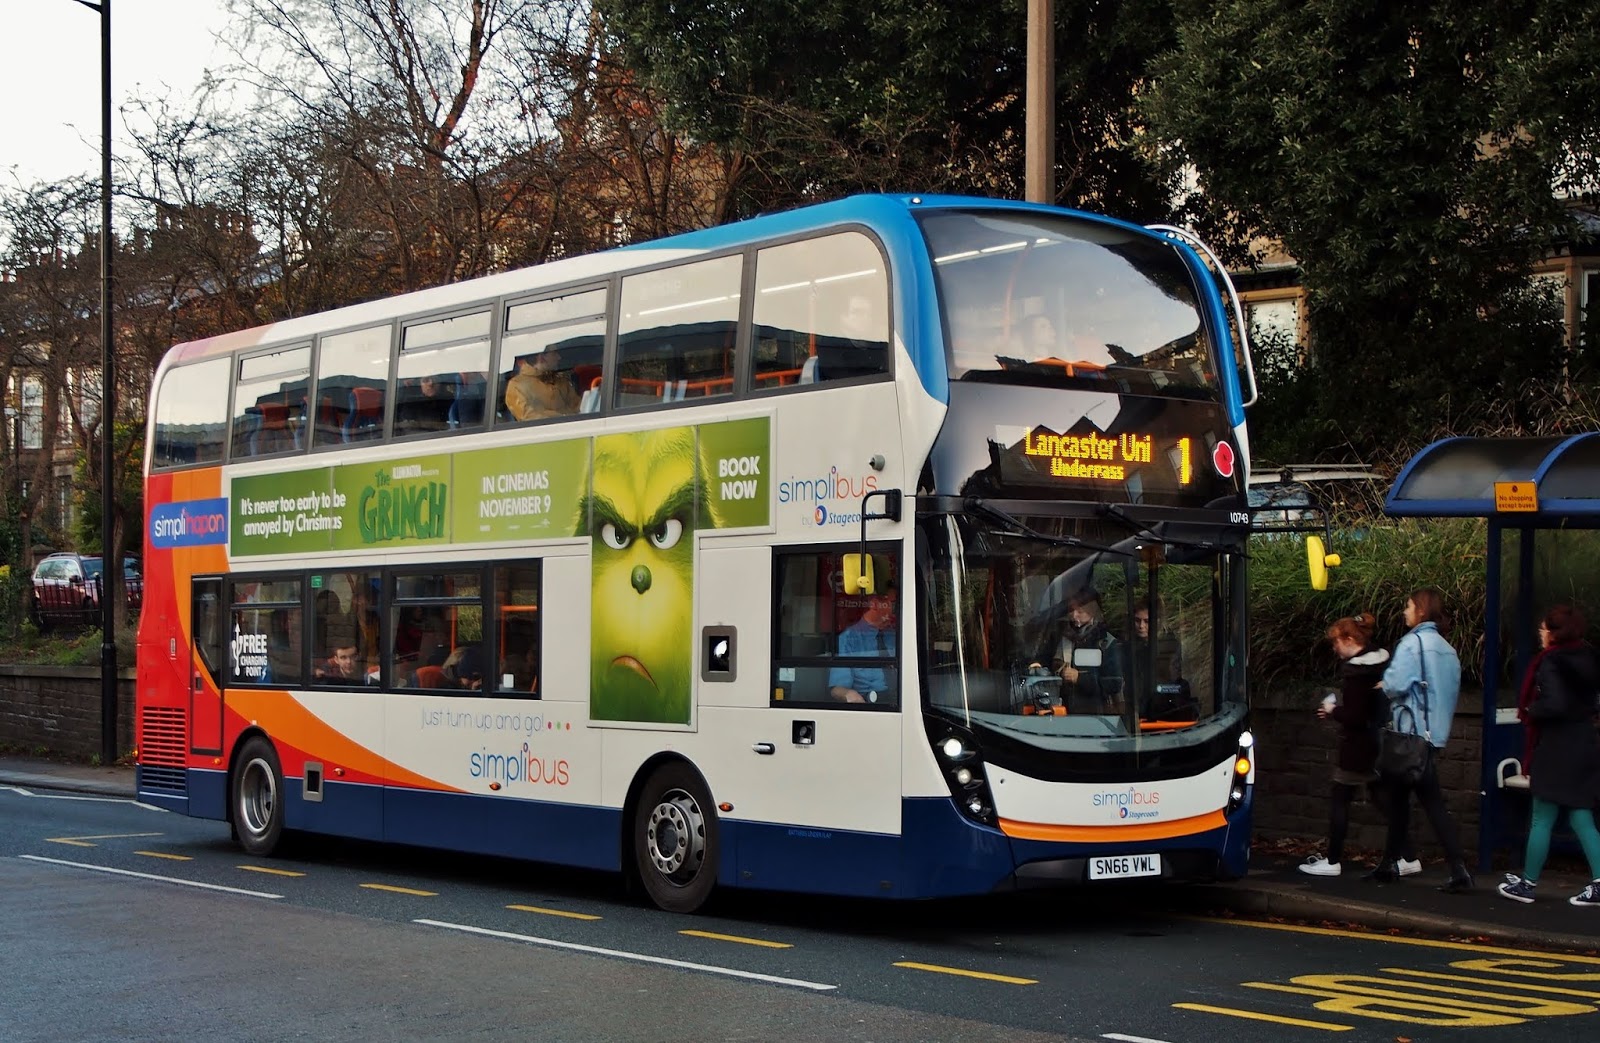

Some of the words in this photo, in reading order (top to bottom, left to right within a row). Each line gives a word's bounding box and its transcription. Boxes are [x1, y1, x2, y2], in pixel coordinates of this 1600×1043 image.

[1025, 427, 1118, 461] Lancaster
[1119, 433, 1151, 463] Uni
[719, 456, 761, 477] BOOK
[1176, 437, 1190, 484] 1
[482, 476, 496, 495] IN
[497, 470, 549, 492] CINEMAS
[721, 479, 757, 501] NOW
[779, 465, 878, 506] simplibus
[241, 497, 254, 516] It's
[254, 500, 279, 514] never
[280, 496, 295, 512] too
[297, 490, 320, 514] early
[321, 492, 331, 508] to
[333, 488, 346, 508] be
[358, 481, 448, 544] GRINCH
[479, 498, 541, 518] NOVEMBER
[543, 495, 551, 513] 9
[244, 514, 281, 539] annoyed
[282, 514, 294, 537] by
[296, 512, 343, 532] Christmas
[829, 510, 876, 527] Stageco
[1230, 511, 1249, 525] 10743
[243, 634, 267, 653] FREE
[240, 655, 268, 666] CHARGING
[246, 666, 262, 677] POINT
[447, 707, 473, 729] turn
[476, 712, 492, 732] up
[496, 712, 521, 731] and
[470, 742, 570, 787] simplibus
[1092, 787, 1160, 808] simplibus
[1096, 858, 1129, 875] SN66
[1133, 856, 1156, 873] VWL
